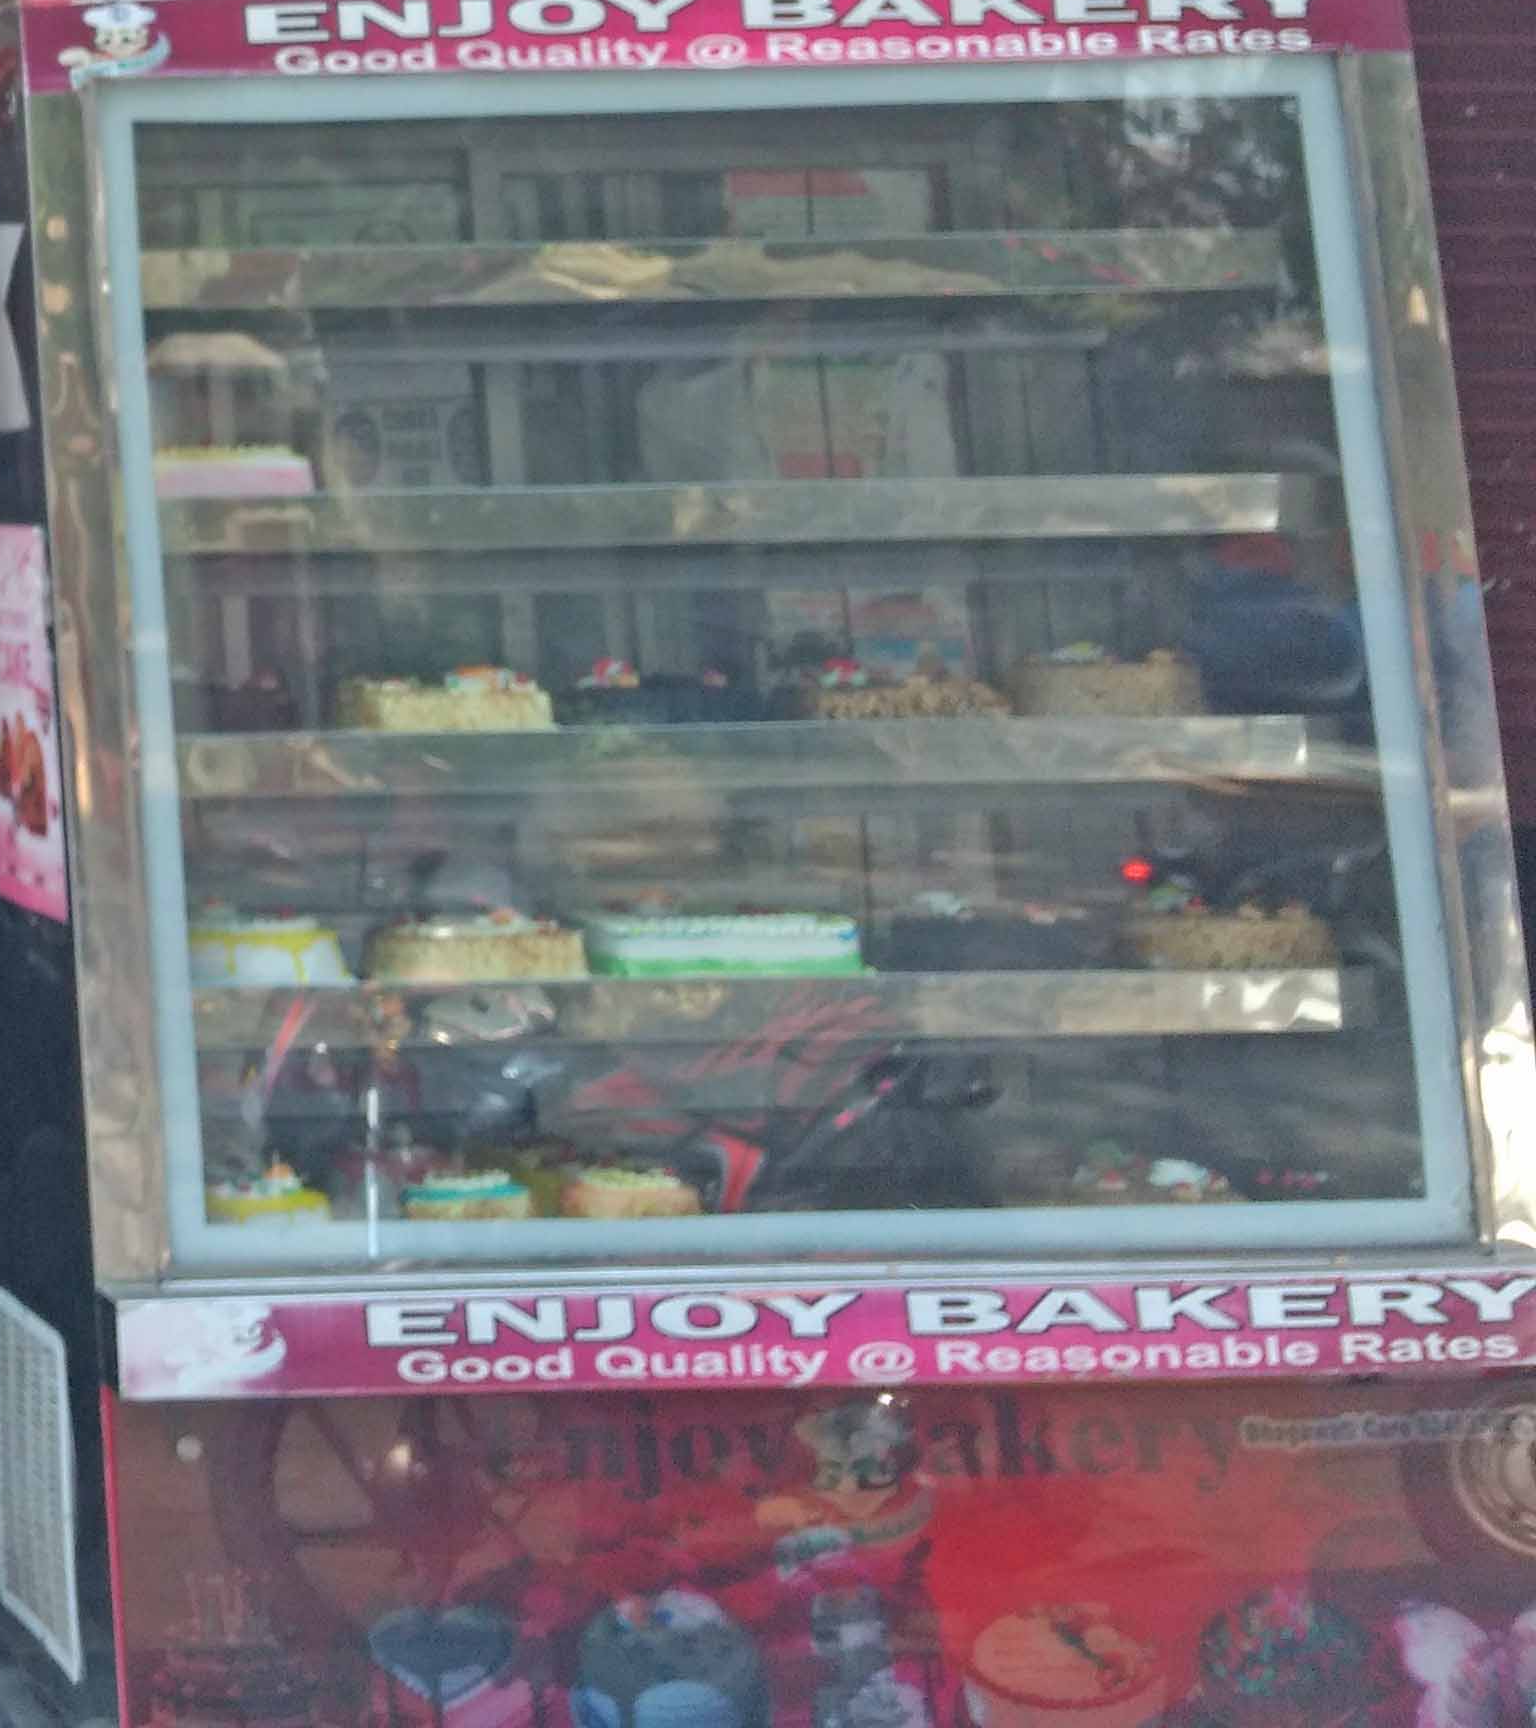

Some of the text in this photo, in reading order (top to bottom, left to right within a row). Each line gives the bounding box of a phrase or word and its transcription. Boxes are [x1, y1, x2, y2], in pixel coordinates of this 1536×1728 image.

[275, 23, 1313, 75] Good Quality @ Reasonable Rates
[366, 1274, 1534, 1346] ENJOY BAKERY
[397, 1330, 1519, 1388] Good Quality @ Reasonable Rates
